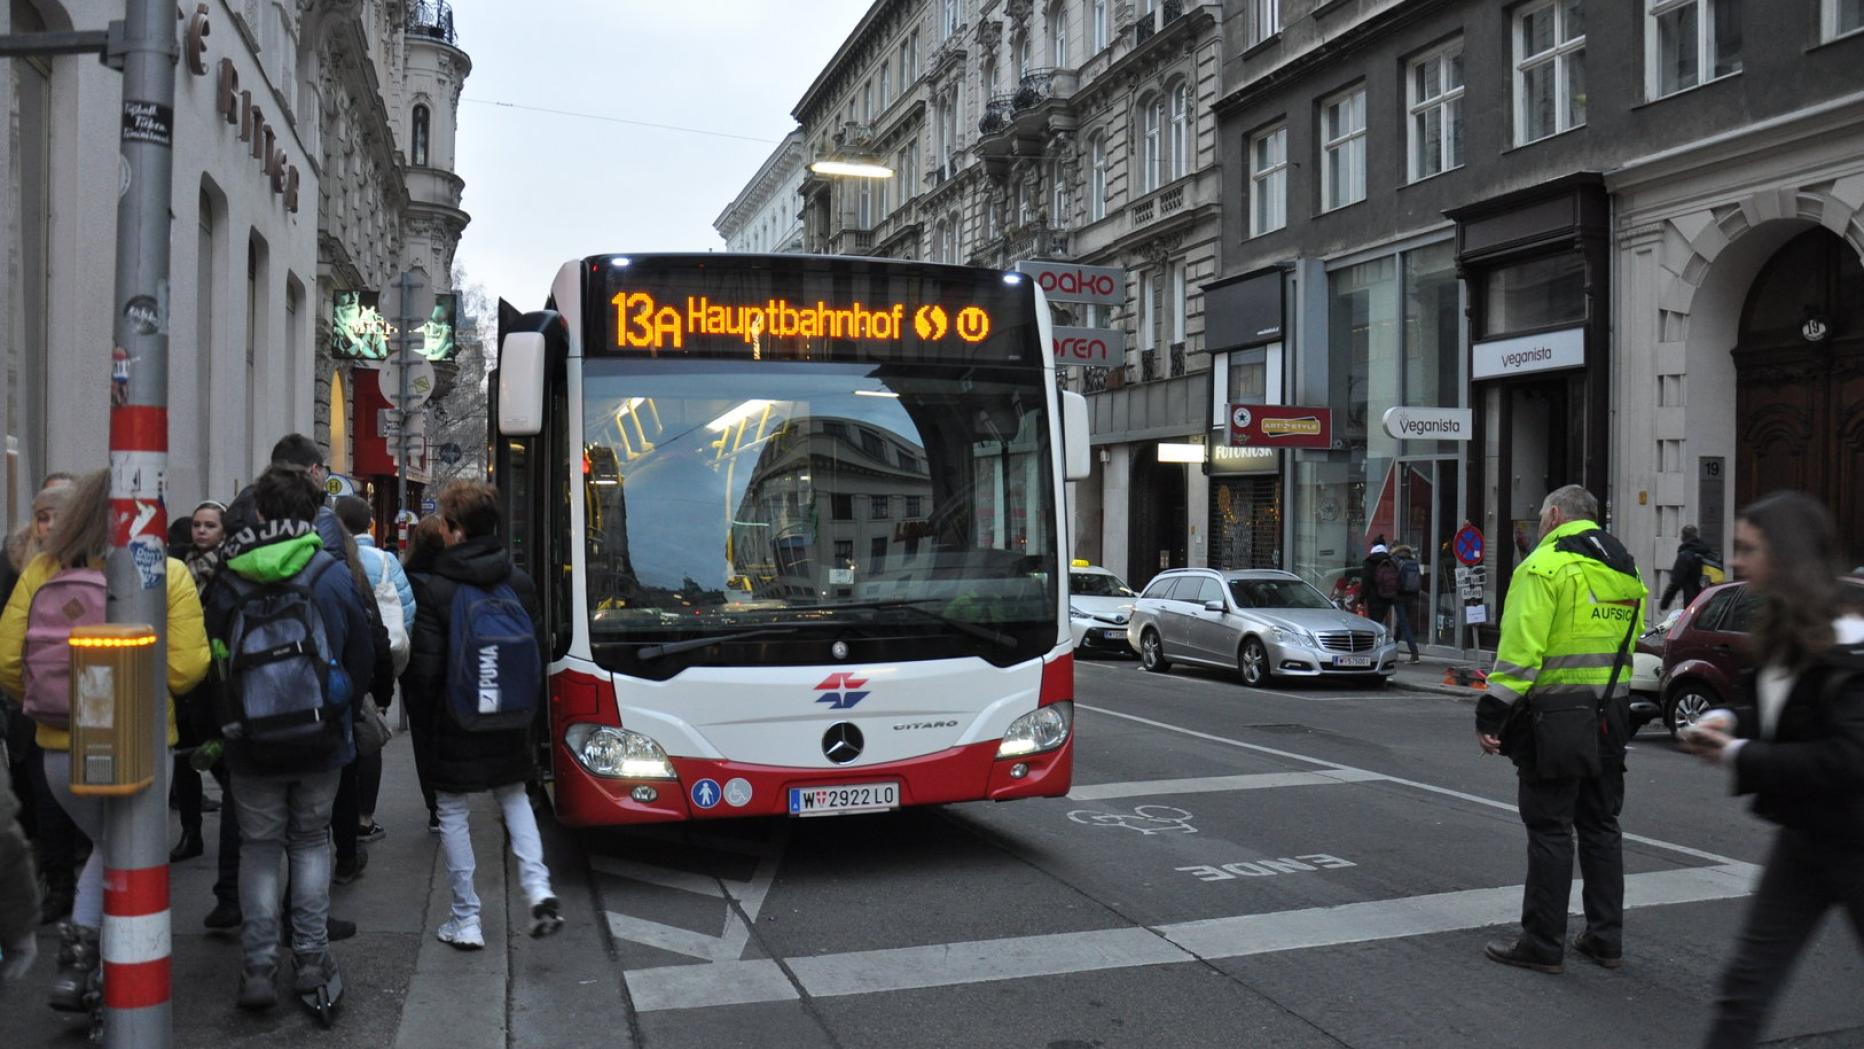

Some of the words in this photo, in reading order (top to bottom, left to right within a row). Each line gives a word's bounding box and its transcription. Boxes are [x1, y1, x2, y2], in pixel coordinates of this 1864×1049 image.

[217, 57, 299, 214] RITTER
[612, 292, 682, 347] 13A
[688, 296, 903, 342] Hauptbahnhof
[1053, 337, 1106, 359] ren
[1705, 462, 1719, 476] 19
[1591, 607, 1632, 621] AUFSIC
[479, 645, 499, 688] PUMA
[893, 720, 959, 730] CITARO
[803, 792, 815, 809] W
[829, 788, 870, 807] 2922
[1174, 853, 1358, 882] ENDE
